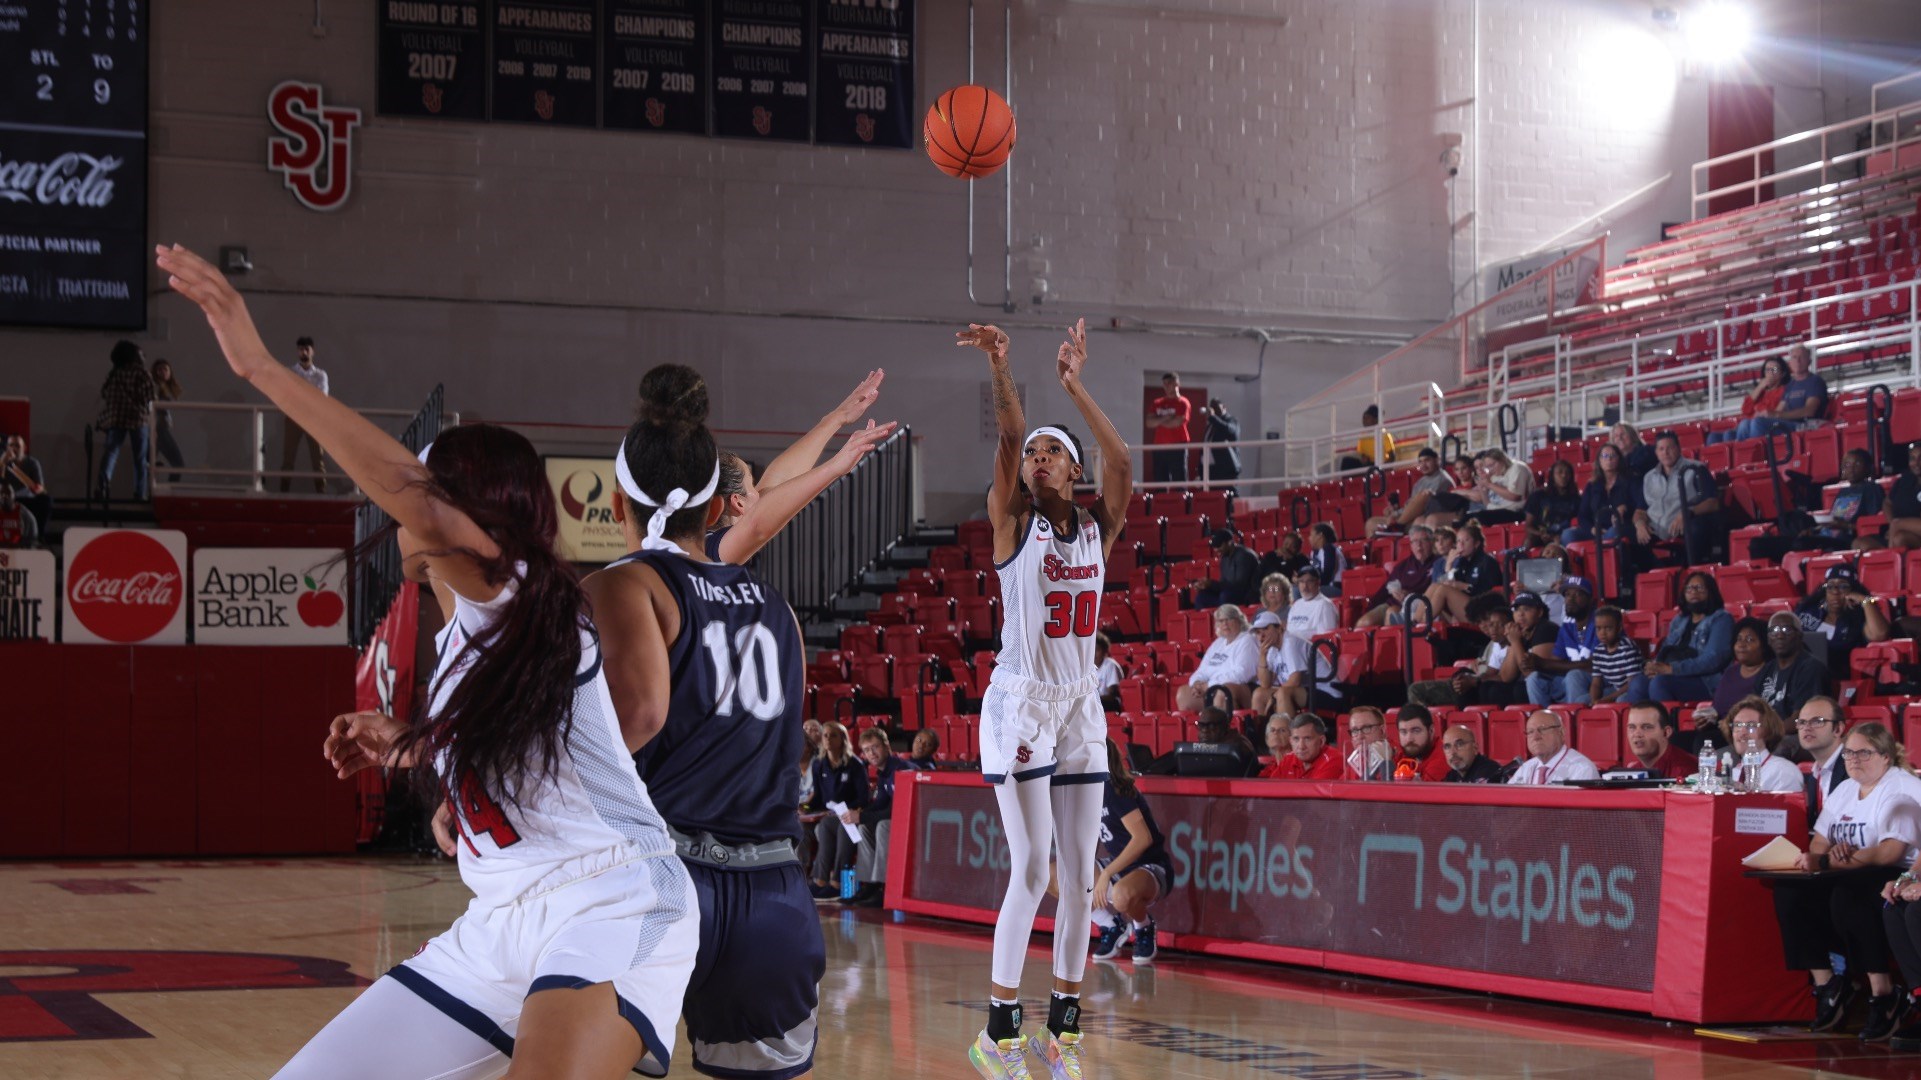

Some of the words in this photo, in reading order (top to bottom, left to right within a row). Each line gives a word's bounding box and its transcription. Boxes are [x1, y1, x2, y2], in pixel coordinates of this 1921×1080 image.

[388, 1, 438, 23] ROUND
[441, 4, 458, 25] OF
[462, 6, 479, 27] 16
[498, 7, 593, 33] APPEARANCES
[827, 5, 904, 27] TOURNAMENT
[613, 15, 696, 39] CHAMPIONS
[722, 22, 802, 47] CHAMPIONS
[401, 32, 464, 52] VOLLEYBALL
[514, 37, 576, 59] VOLLEYBALL
[822, 32, 909, 58] APPEARANCES
[30, 48, 60, 68] STL
[91, 53, 114, 71] TO
[408, 52, 458, 80] 2007
[624, 47, 685, 67] VOLLEYBALL
[732, 55, 791, 75] VOLLEYBALL
[532, 62, 558, 78] 2007
[566, 65, 592, 81] 2019
[612, 68, 649, 90] 2007
[661, 72, 695, 94] 2019
[836, 63, 895, 83] VOLLEYBALL
[36, 74, 53, 101] 2
[94, 78, 111, 104] 9
[750, 79, 775, 94] 2007
[845, 84, 887, 110] 2018
[44, 237, 101, 255] PARTNER
[0, 274, 29, 295] STA
[1537, 288, 1574, 306] SANGS
[586, 508, 617, 523] PR
[582, 526, 623, 536] PHYSICA
[72, 570, 178, 606] Coca-Cola
[198, 566, 297, 600] Apple
[198, 600, 289, 628] Bank
[1044, 590, 1097, 638] 30
[702, 620, 785, 722] 10
[1170, 821, 1314, 912] Staples
[1436, 835, 1635, 944] Staples
